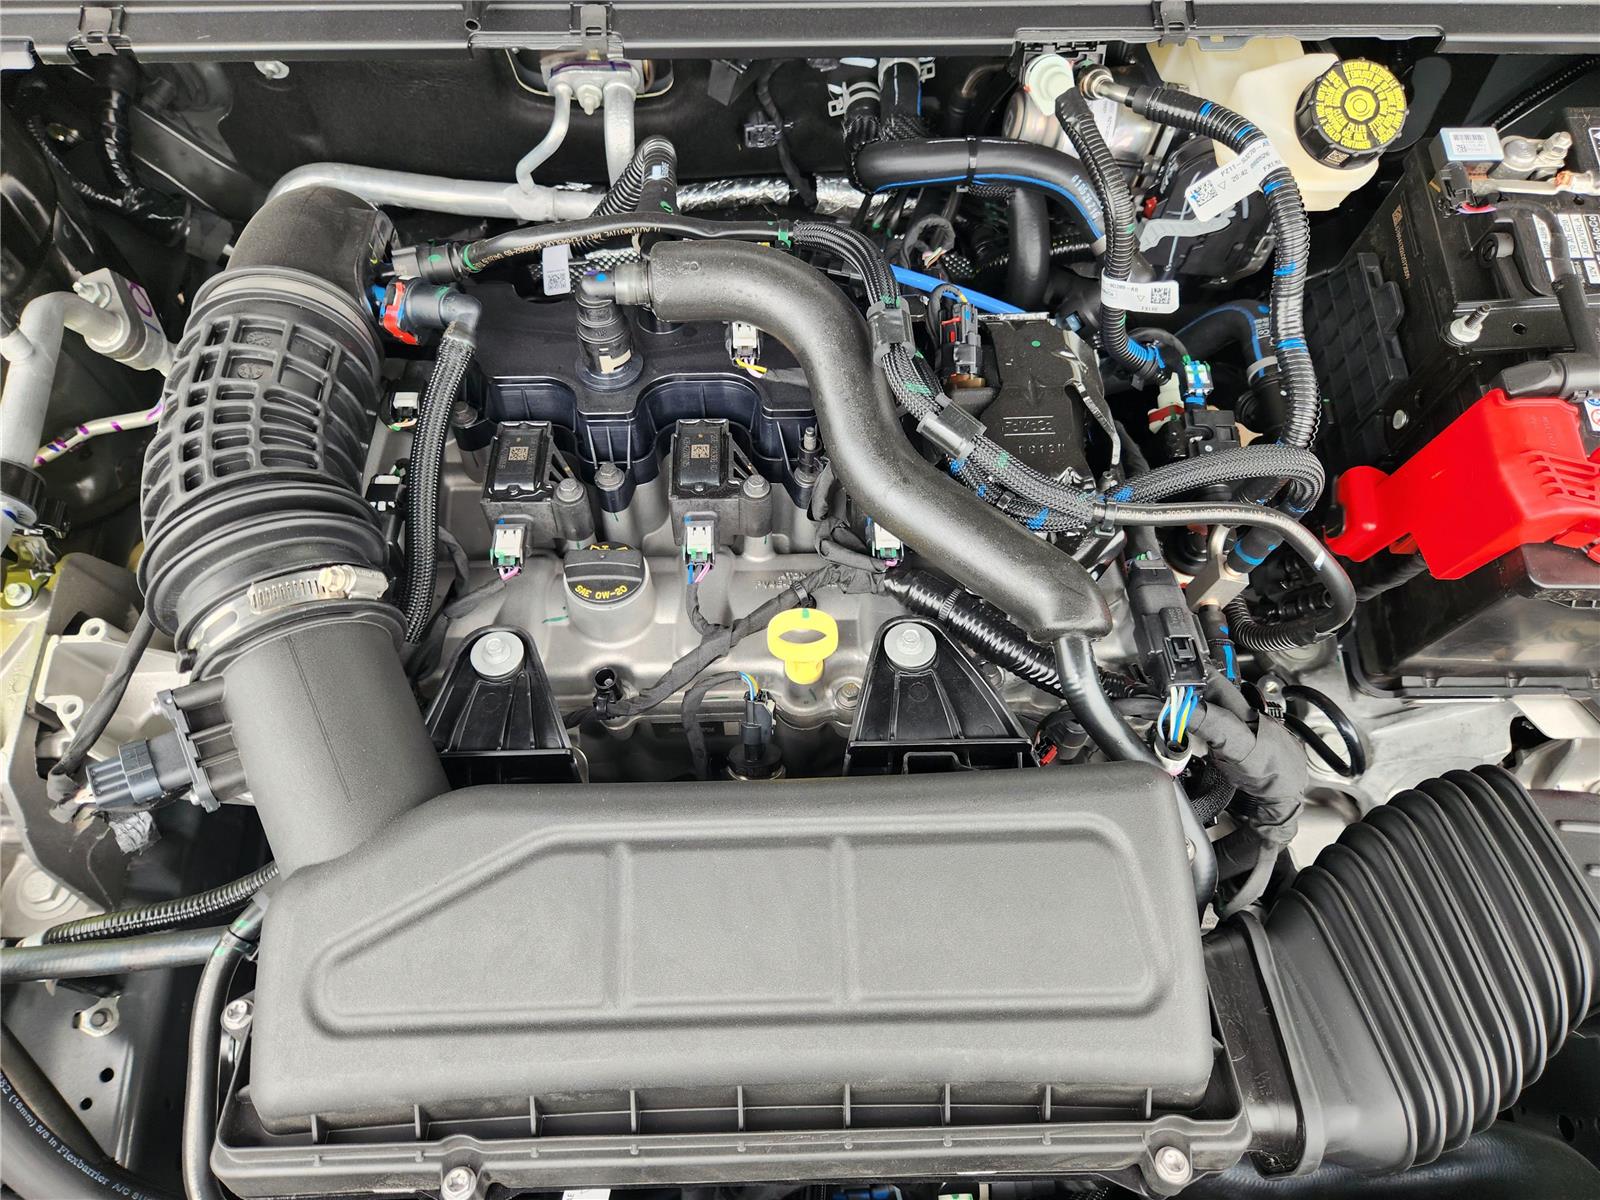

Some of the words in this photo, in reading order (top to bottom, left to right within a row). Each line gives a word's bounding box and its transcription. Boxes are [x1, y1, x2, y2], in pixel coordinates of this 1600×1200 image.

[1322, 122, 1341, 142] SEALED
[605, 227, 651, 238] AUTOMOTIVE
[574, 584, 592, 598] SAE
[595, 585, 628, 599] 0W-20
[8, 1094, 37, 1127] (16mm)
[35, 1125, 50, 1139] 5/8
[48, 1137, 57, 1148] in
[57, 1145, 110, 1185] Flexbarrier
[112, 1184, 130, 1196] A/C
